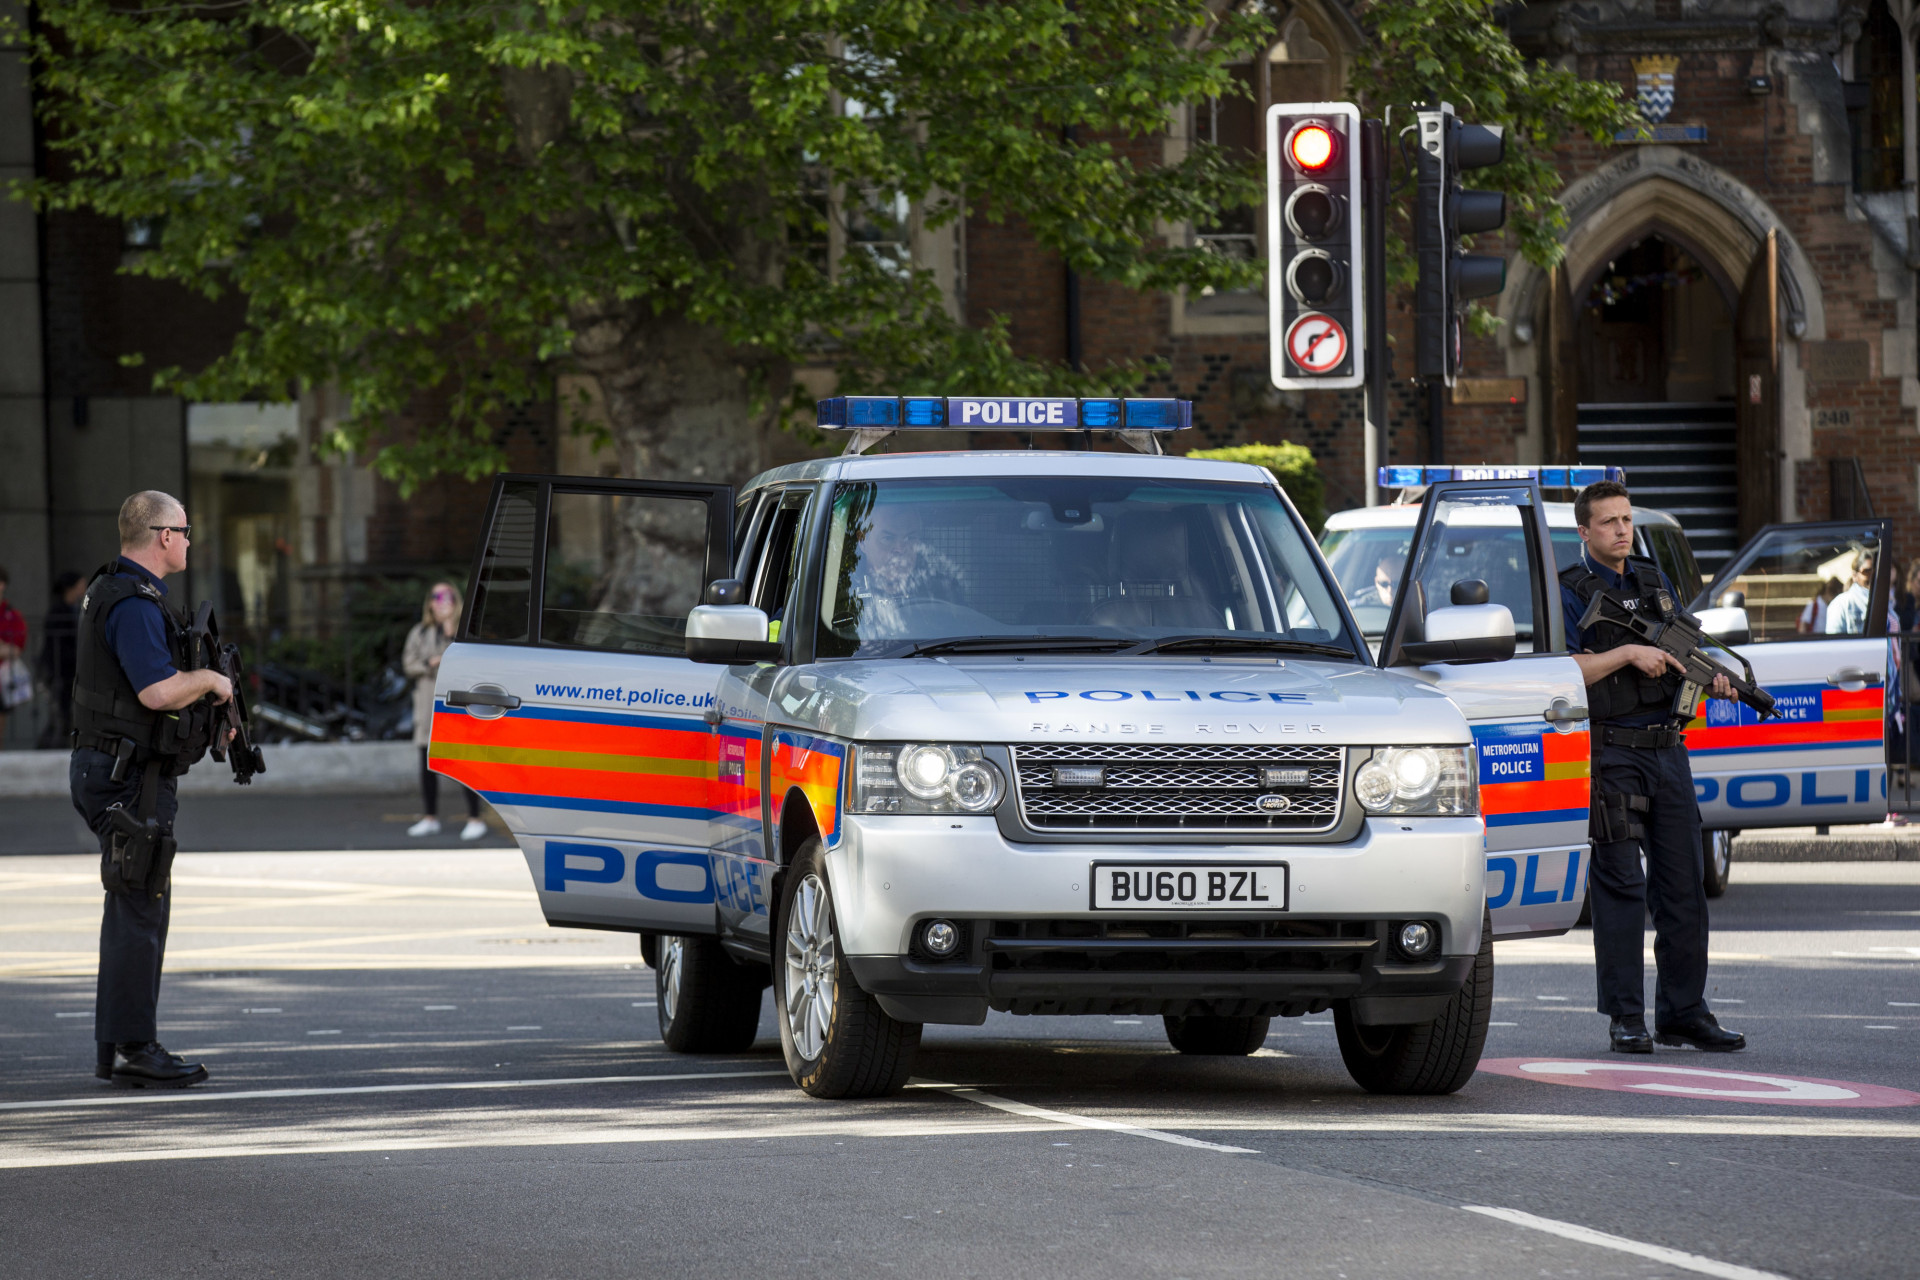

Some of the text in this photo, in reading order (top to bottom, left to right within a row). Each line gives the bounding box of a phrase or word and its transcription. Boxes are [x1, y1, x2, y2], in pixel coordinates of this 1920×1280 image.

[962, 401, 1064, 424] POLICE
[1462, 469, 1530, 481] POLICE
[535, 683, 714, 708] www.met.police.uk
[1024, 689, 1313, 706] POLICE
[1029, 722, 1326, 734] RANGE ROVER
[1483, 743, 1539, 756] METROPOLITAN
[1492, 760, 1532, 775] POLICE
[1694, 769, 1887, 809] OLI
[1111, 871, 1270, 902] BU60 BZL
[1487, 851, 1591, 910] OLI
